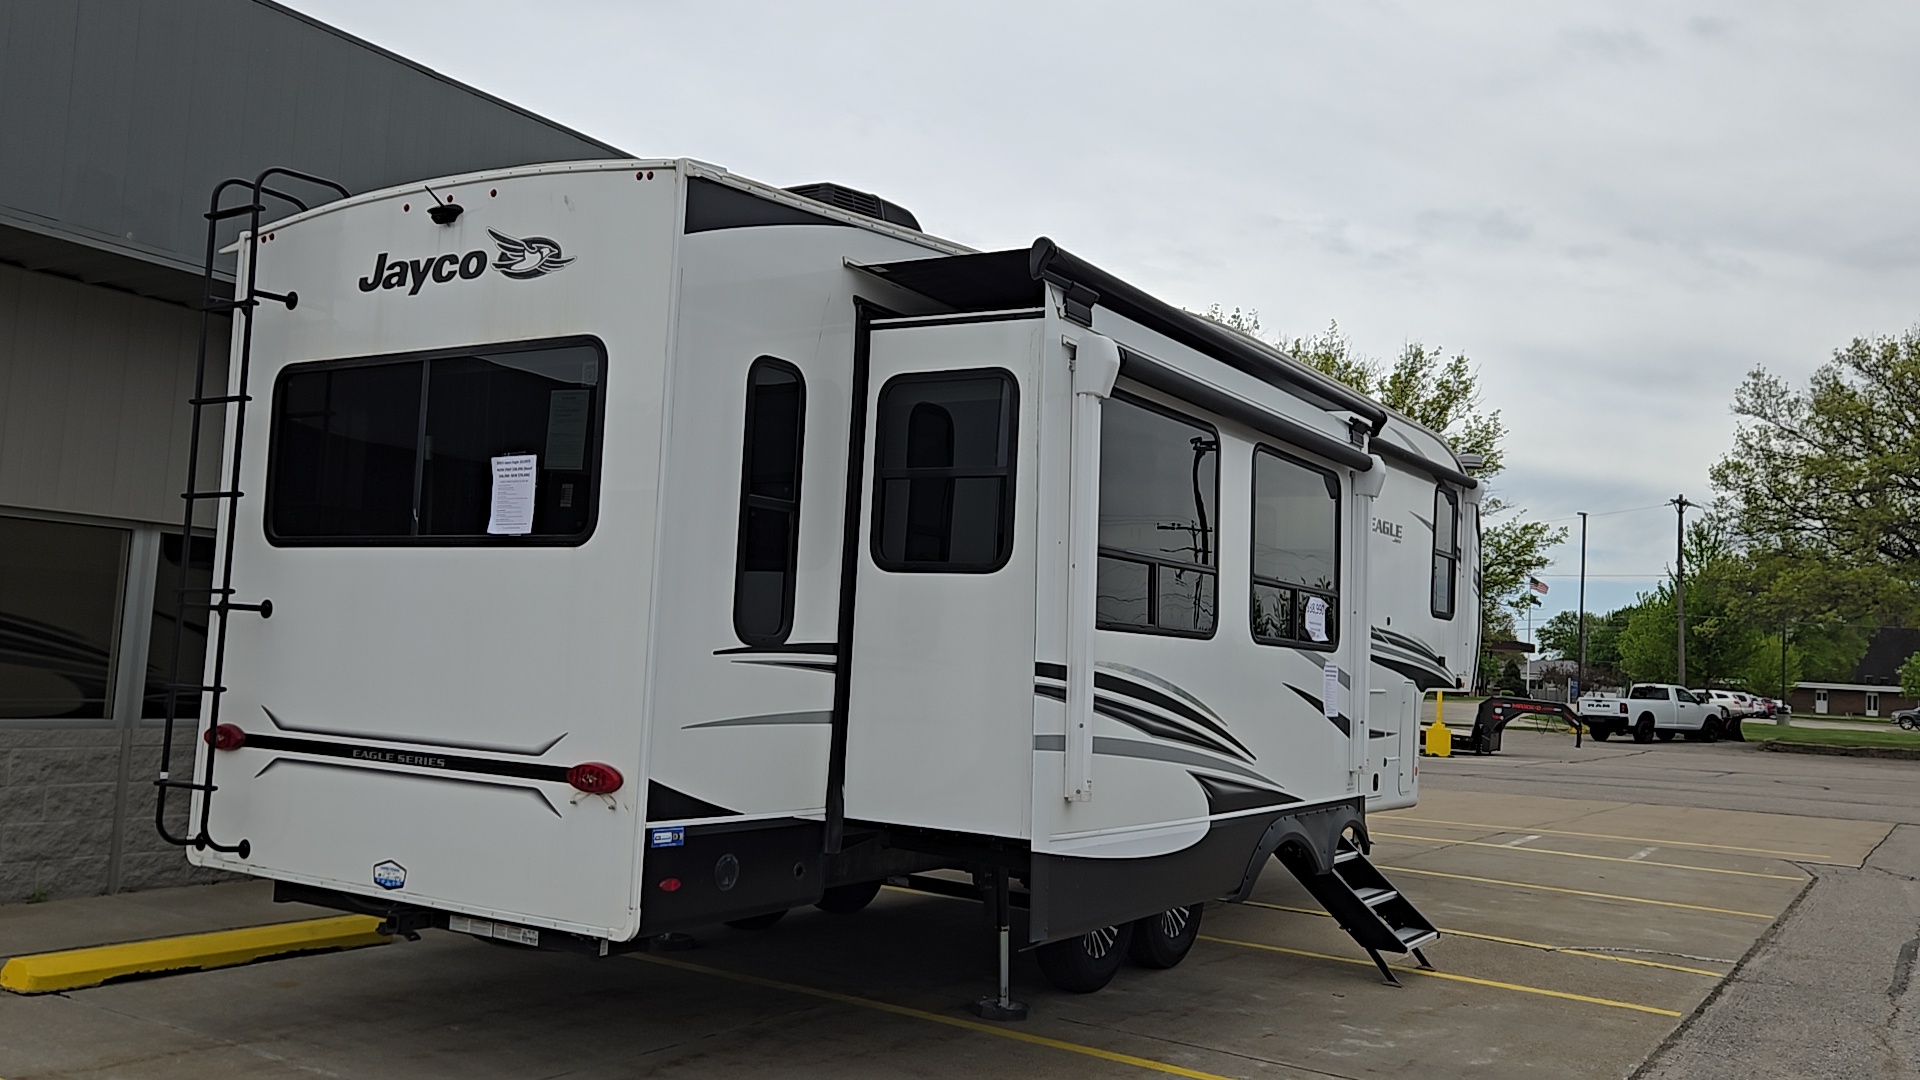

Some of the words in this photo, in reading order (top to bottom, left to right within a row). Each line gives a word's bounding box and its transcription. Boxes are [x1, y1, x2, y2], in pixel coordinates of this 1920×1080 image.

[358, 249, 488, 296] Jayco
[352, 749, 395, 761] EAGLE
[397, 754, 446, 767] SERIES
